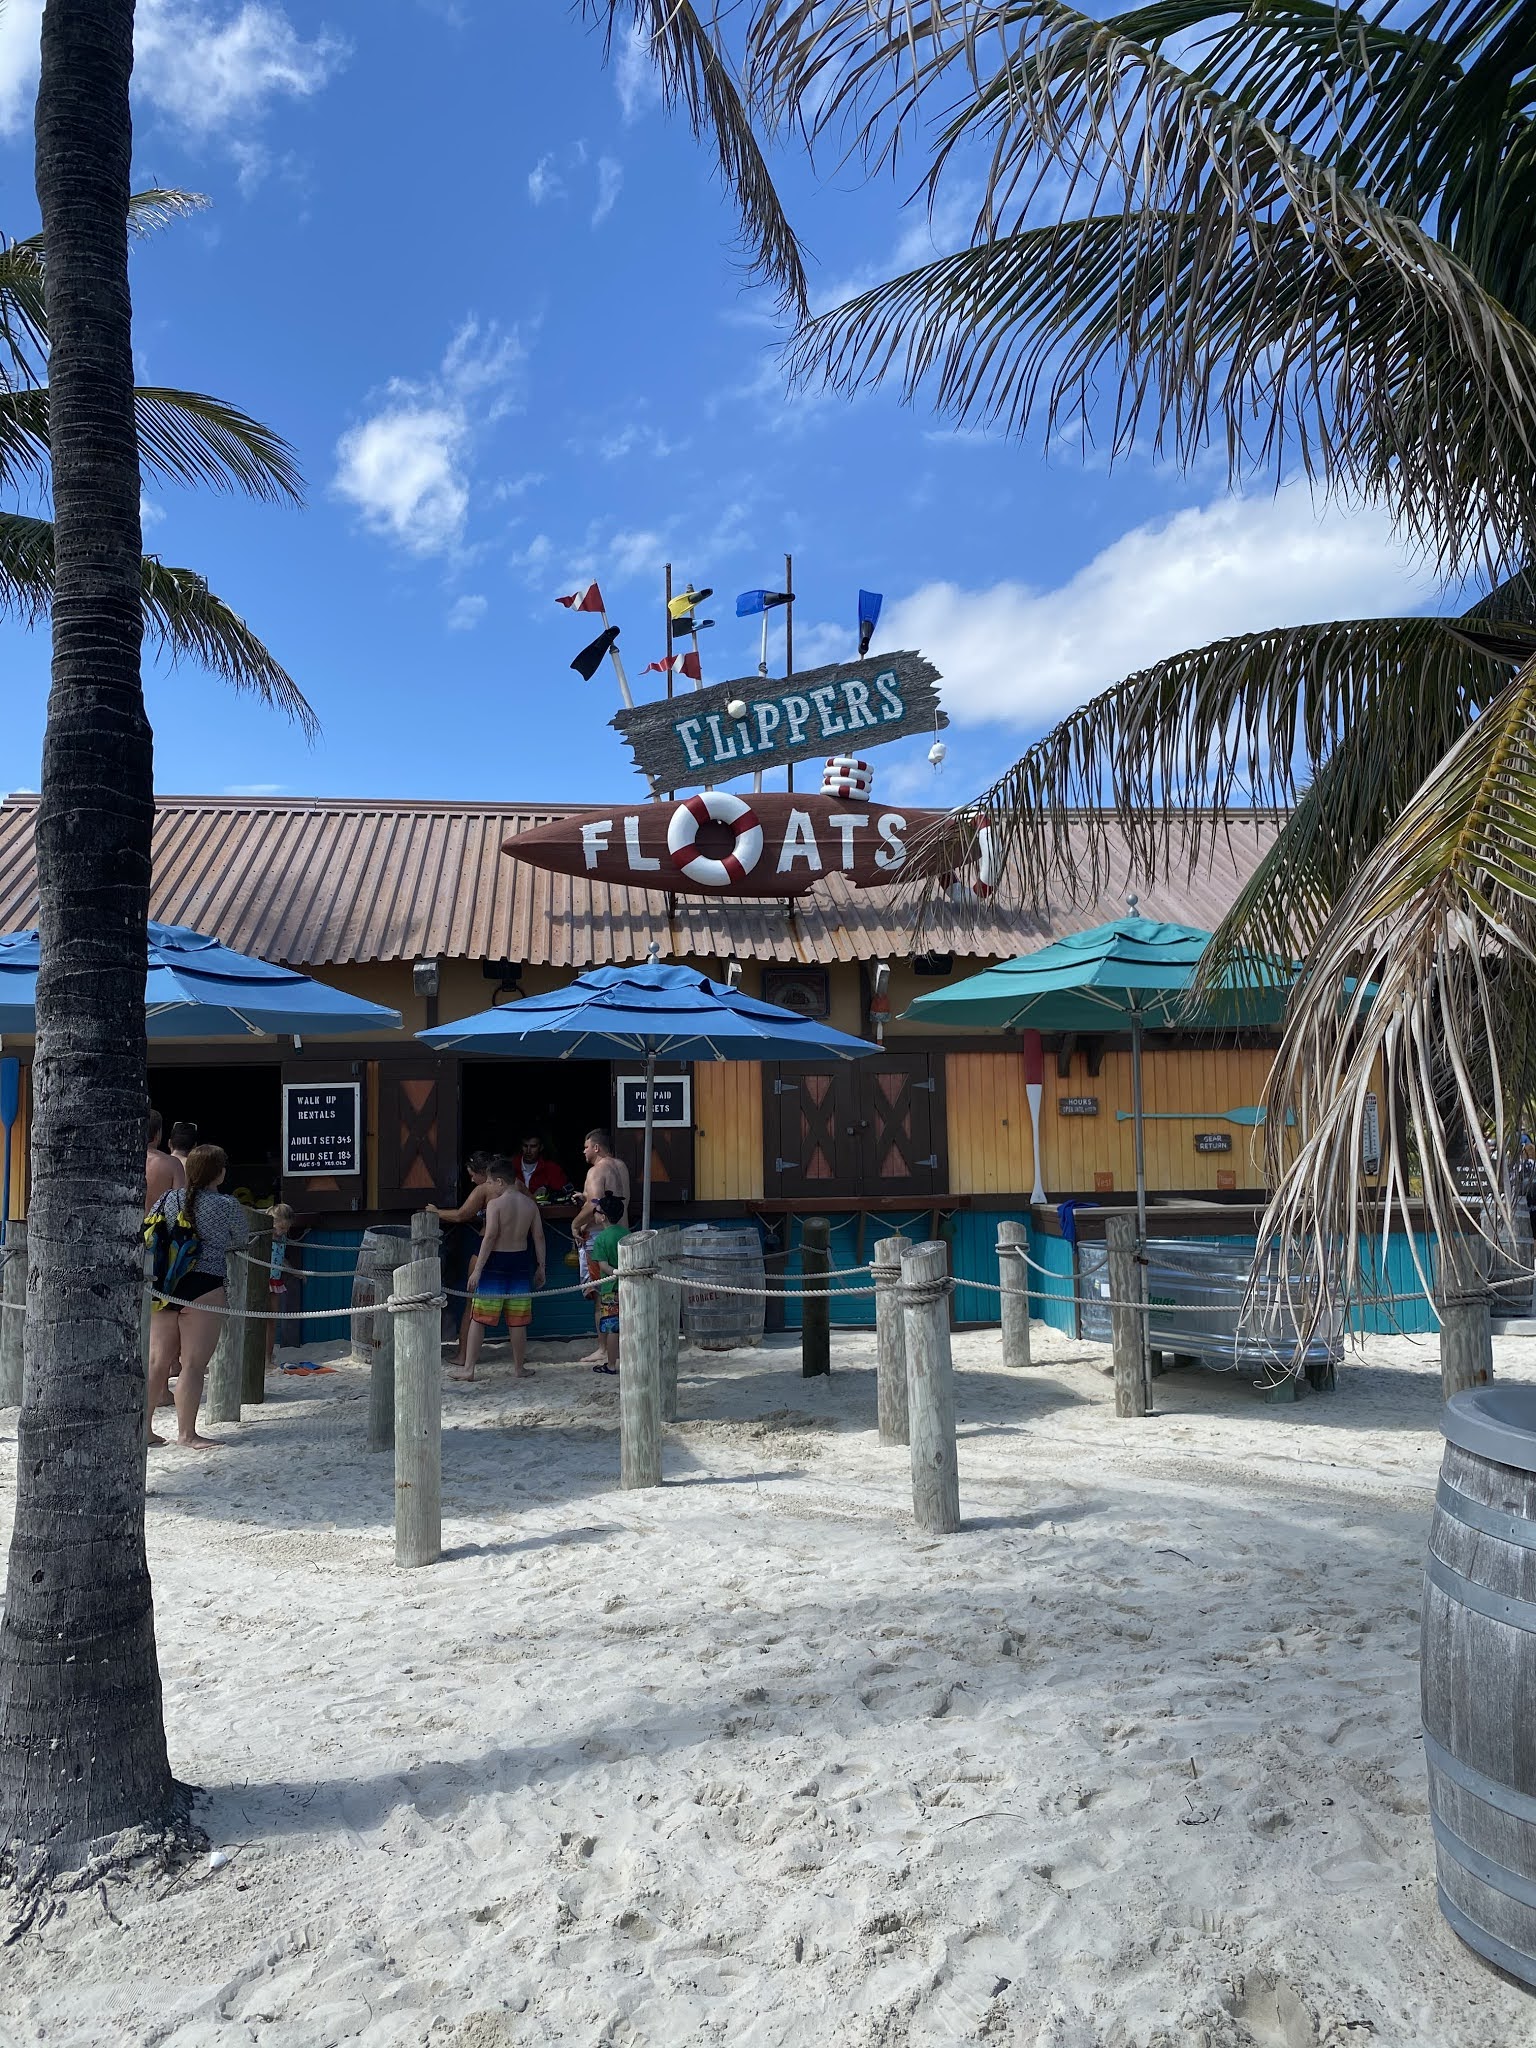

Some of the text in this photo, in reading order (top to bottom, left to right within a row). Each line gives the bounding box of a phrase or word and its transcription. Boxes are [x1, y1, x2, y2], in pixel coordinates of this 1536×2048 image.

[579, 791, 907, 887] FLOATS
[297, 1096, 320, 1104] WALK
[638, 1104, 670, 1112] TIETS
[298, 1110, 336, 1120] RENTALS
[291, 1136, 317, 1145] ADULT
[337, 1136, 352, 1144] 34$
[291, 1151, 351, 1161] CHILD SET 18$
